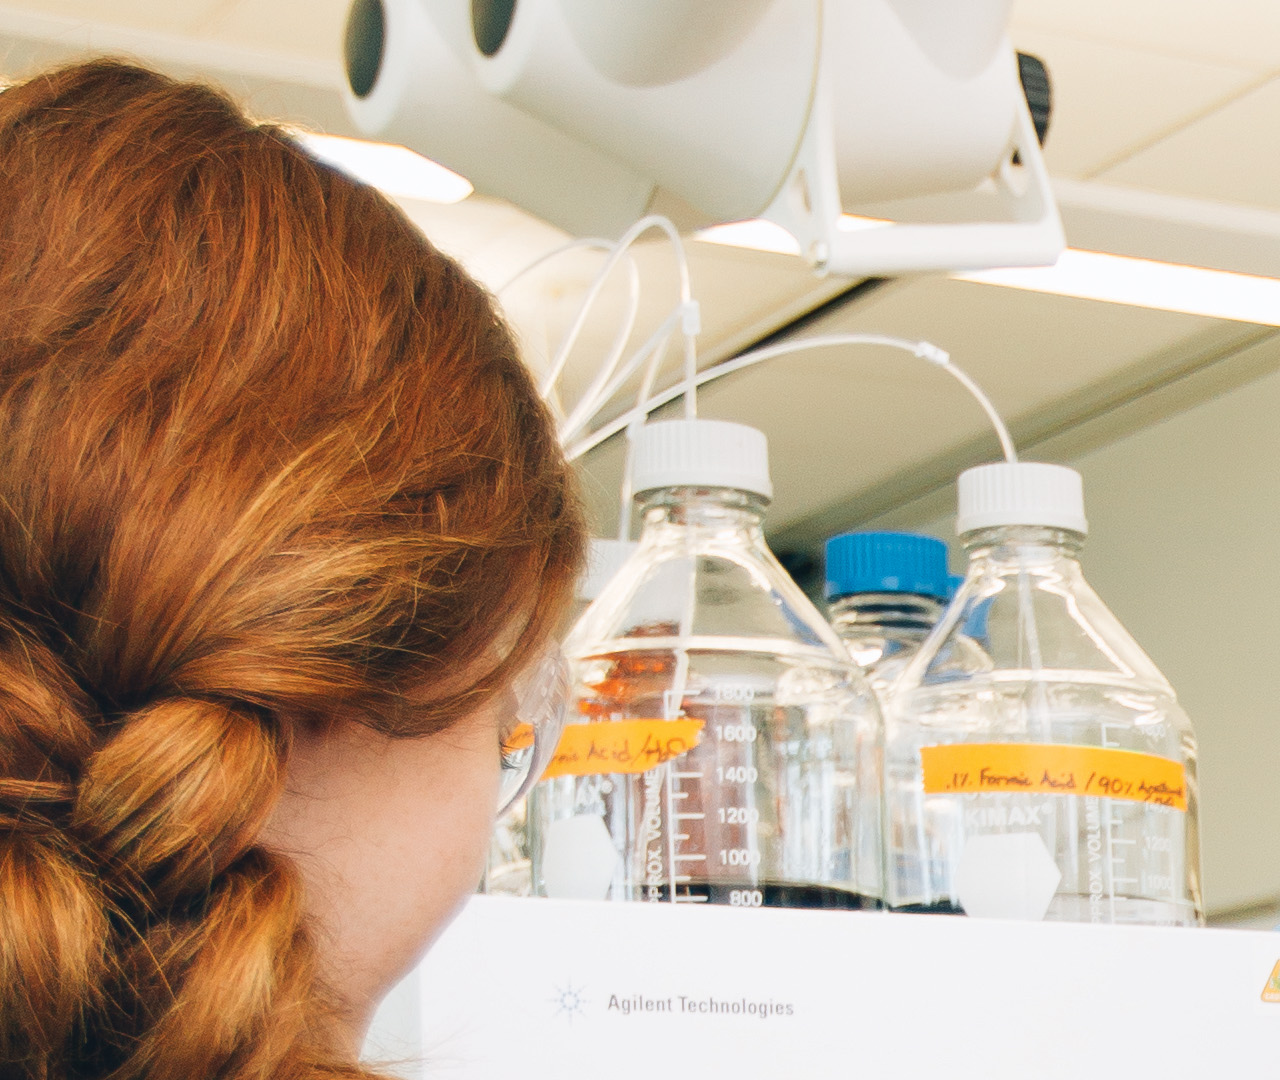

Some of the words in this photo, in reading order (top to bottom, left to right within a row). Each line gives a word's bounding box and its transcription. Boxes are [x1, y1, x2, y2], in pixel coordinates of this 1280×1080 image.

[715, 725, 757, 743] 1600
[716, 767, 758, 784] 1400
[980, 768, 1032, 787] Formic
[1040, 770, 1076, 789] Acid
[717, 807, 759, 824] 1200
[719, 849, 761, 866] 1000
[729, 890, 763, 907] 800
[608, 993, 672, 1016] Agilent
[678, 996, 795, 1018] Technologies
